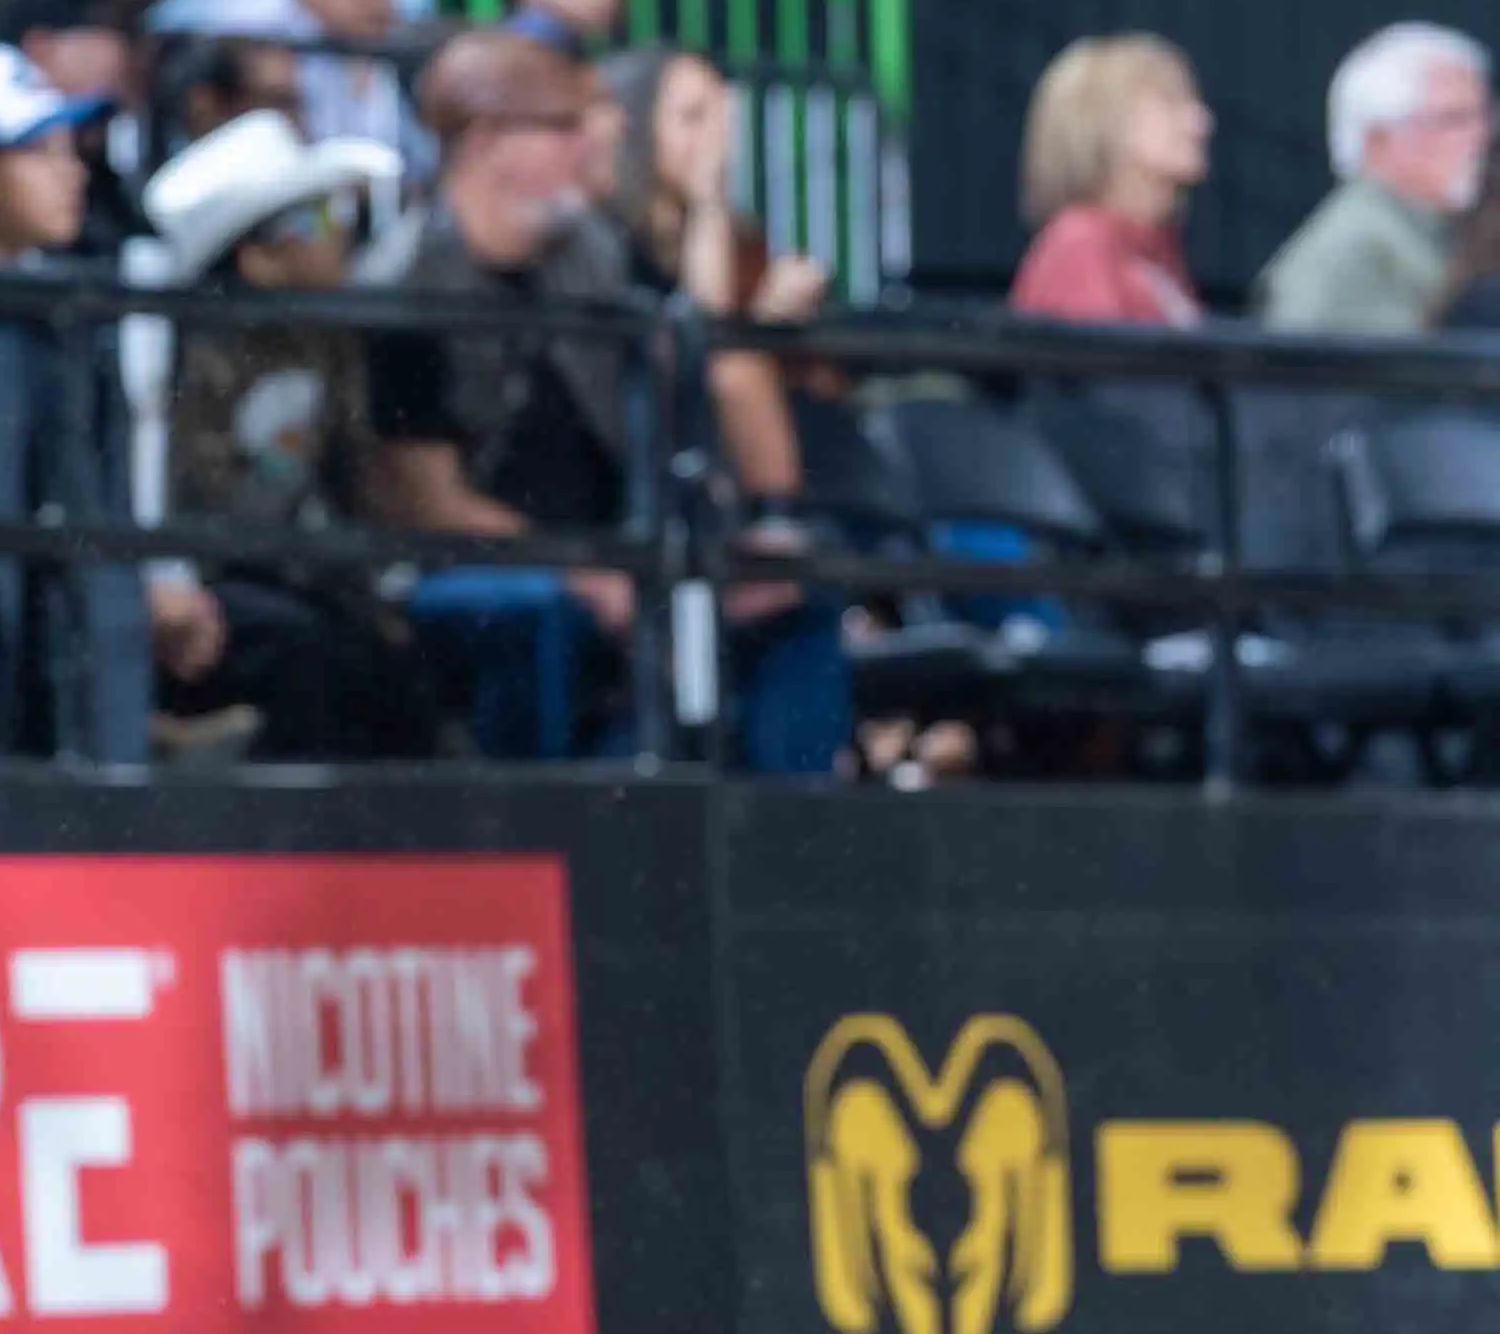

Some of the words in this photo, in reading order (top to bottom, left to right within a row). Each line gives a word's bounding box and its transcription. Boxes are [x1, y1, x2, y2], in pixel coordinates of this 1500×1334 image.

[217, 945, 542, 1117] NICOTINE
[230, 1132, 557, 1308] POUCHES
[1096, 1117, 1500, 1273] RA
